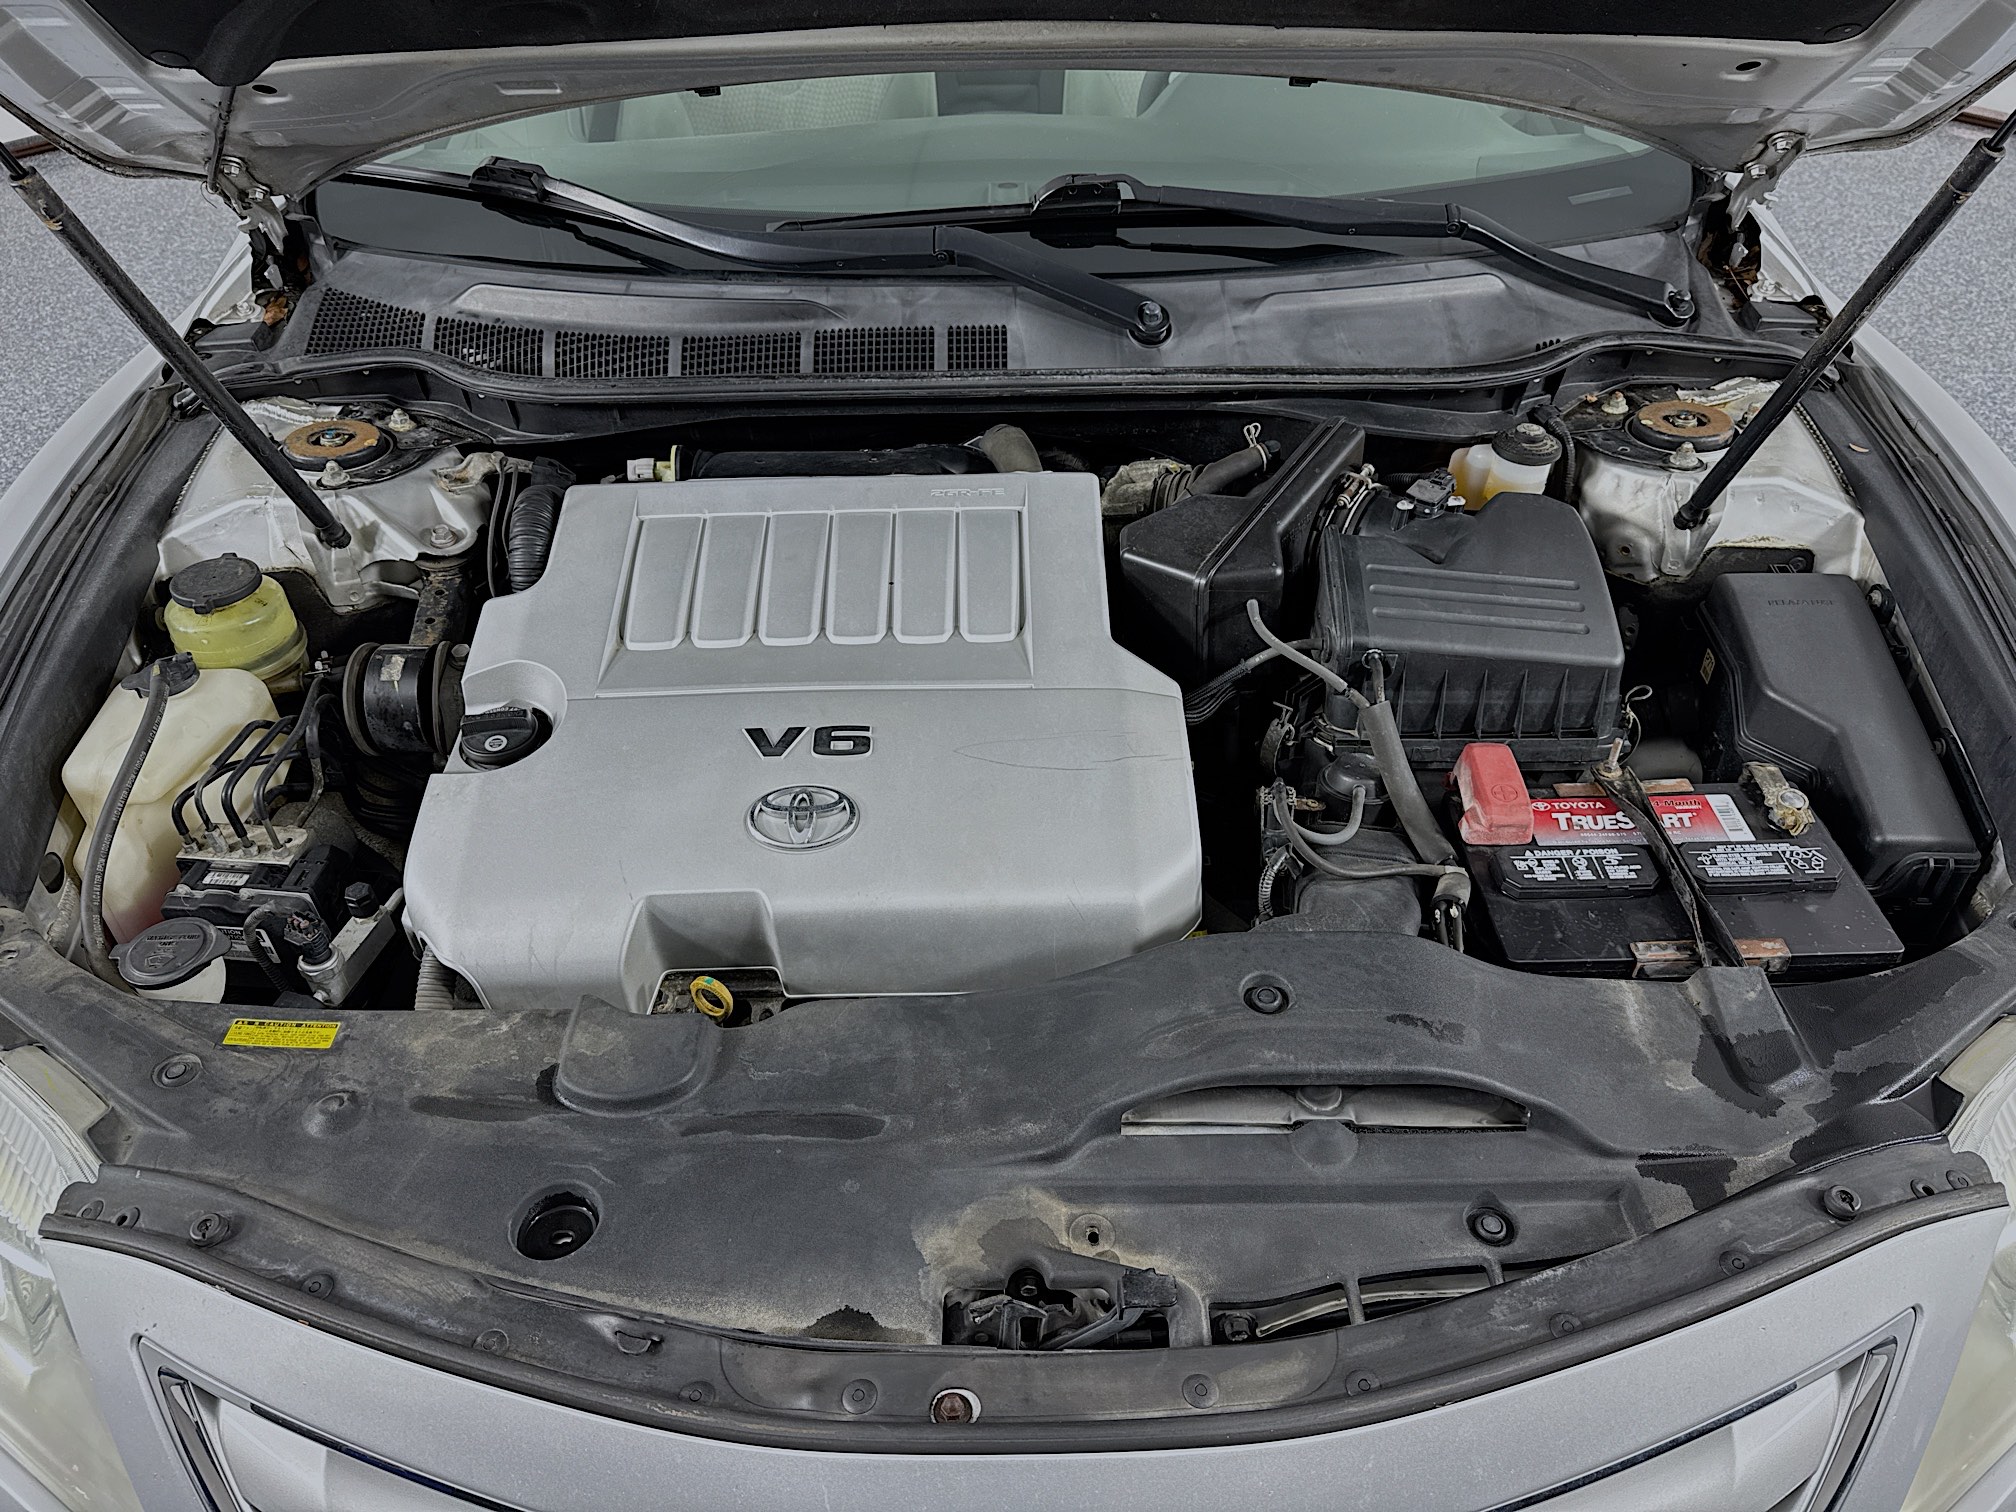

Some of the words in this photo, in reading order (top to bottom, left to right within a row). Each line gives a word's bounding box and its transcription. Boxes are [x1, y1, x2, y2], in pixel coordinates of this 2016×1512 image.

[742, 725, 872, 759] V6
[1551, 801, 1606, 810] TOYOTA
[1582, 848, 1619, 856] POISON
